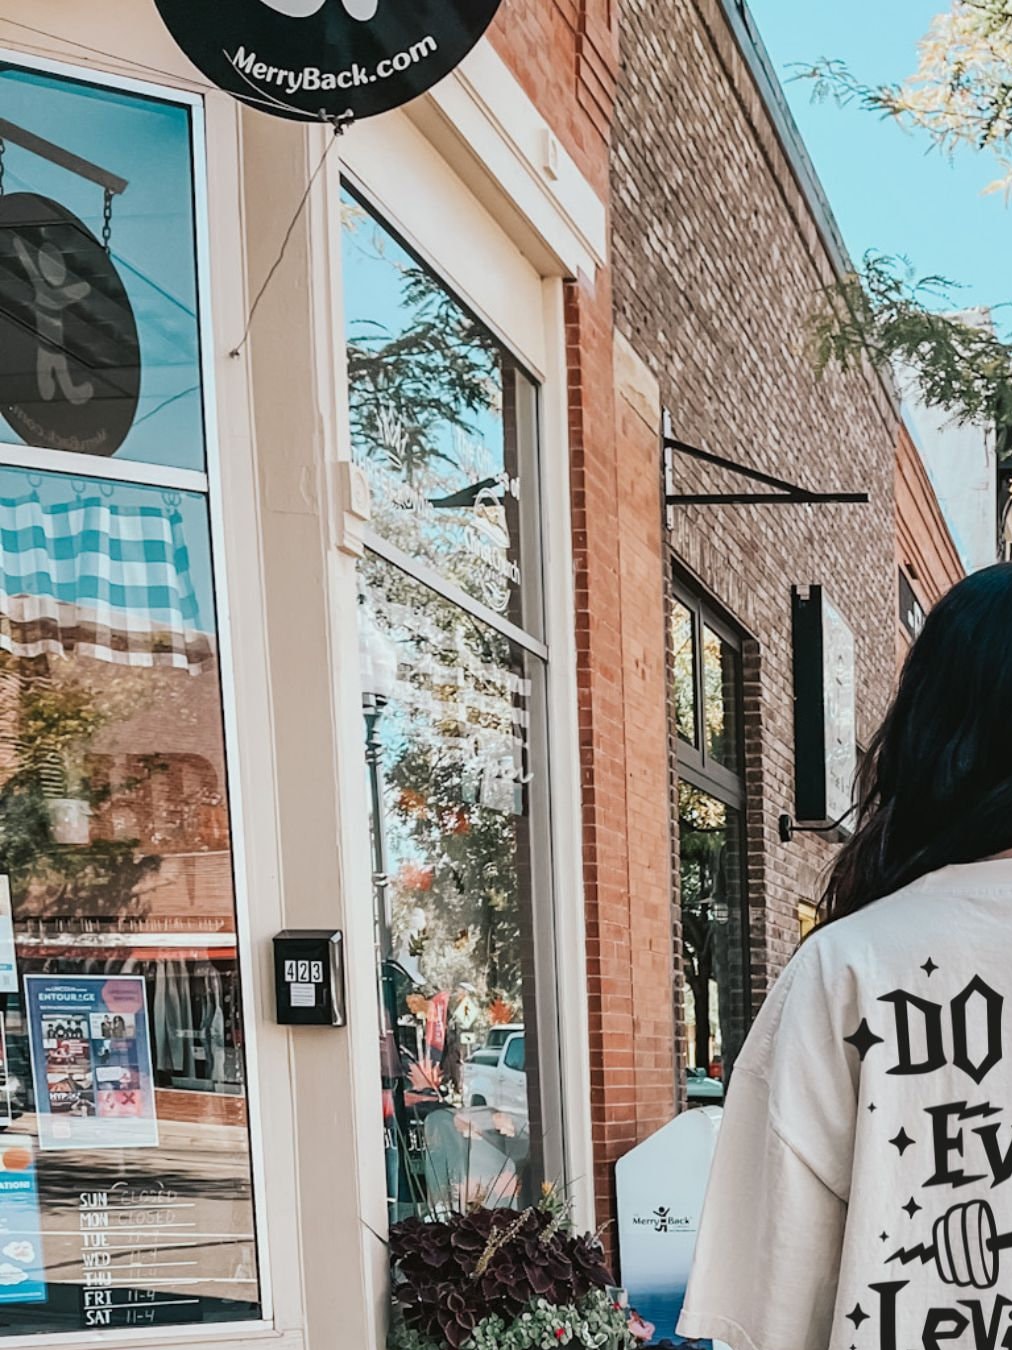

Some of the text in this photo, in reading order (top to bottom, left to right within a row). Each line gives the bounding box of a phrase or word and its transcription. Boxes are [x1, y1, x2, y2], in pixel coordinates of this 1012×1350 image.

[232, 35, 438, 94] MerryBack.com
[287, 961, 321, 981] 423
[876, 974, 1004, 1086] DO
[80, 1189, 178, 1208] SUN CLOSED
[79, 1210, 177, 1228] MON CLOSED
[82, 1232, 110, 1247] TUE
[82, 1252, 111, 1267] WED
[83, 1272, 112, 1288] THU
[84, 1289, 156, 1306] FRI 11-4
[85, 1308, 156, 1326] SAT 11-4
